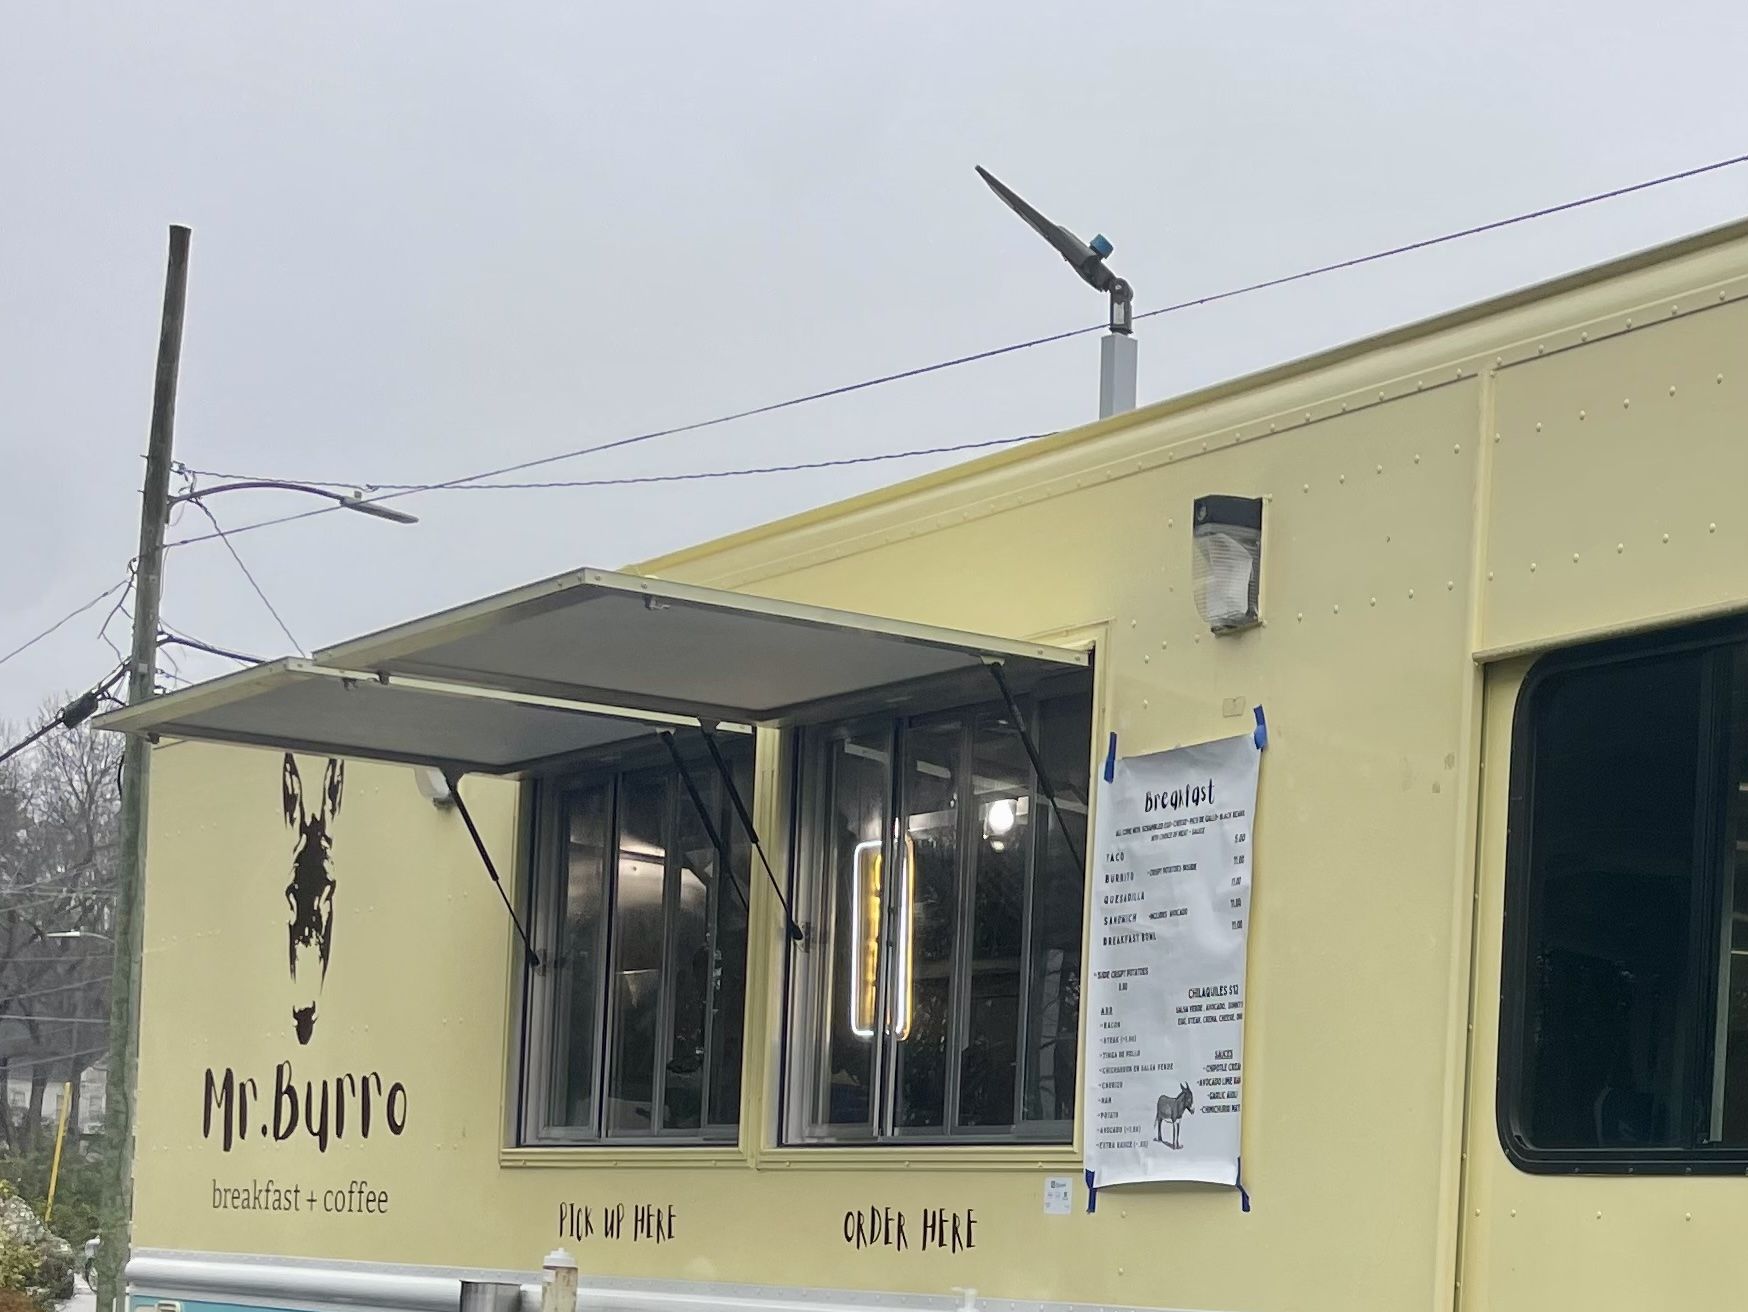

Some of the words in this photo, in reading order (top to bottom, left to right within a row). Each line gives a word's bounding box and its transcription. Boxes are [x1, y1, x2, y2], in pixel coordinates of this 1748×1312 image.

[1106, 851, 1125, 862] TACO
[1104, 871, 1135, 884] BURRITO
[1103, 891, 1145, 905] QUESADILLA
[1103, 912, 1137, 926] SANDWICH
[1102, 933, 1140, 946] BREAKFAST
[1141, 931, 1157, 942] BOWL
[211, 1178, 300, 1212] breakfast
[306, 1190, 318, 1212] +
[323, 1180, 389, 1214] coffee
[559, 1201, 594, 1242] PICK
[604, 1202, 625, 1240] UP
[633, 1203, 677, 1244] HERE
[843, 1204, 909, 1252] ORDER
[921, 1207, 978, 1254] HERE
